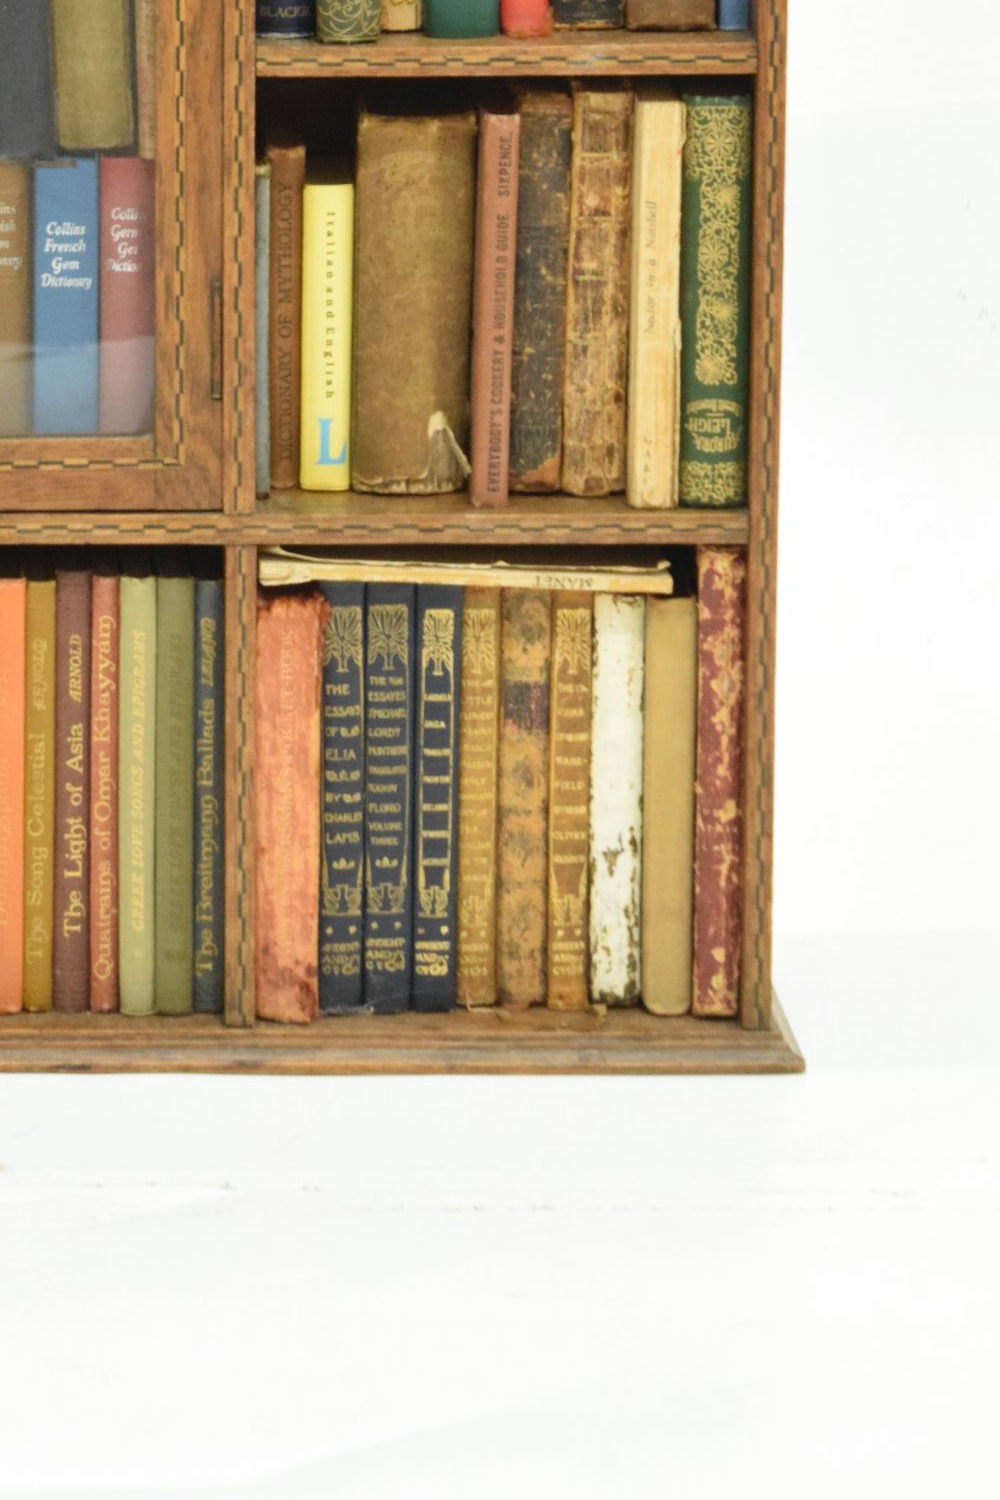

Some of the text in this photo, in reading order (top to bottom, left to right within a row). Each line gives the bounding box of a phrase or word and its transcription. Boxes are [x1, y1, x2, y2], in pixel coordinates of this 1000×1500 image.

[44, 239, 87, 253] French
[46, 221, 86, 236] Collins
[277, 181, 293, 304] MYTHOLOGY
[40, 273, 93, 290] Dictionary
[51, 257, 80, 273] Gem
[323, 211, 336, 399] Italian and English
[493, 256, 510, 329] HOUSEHOLD
[279, 315, 292, 339] OF
[490, 349, 506, 404] COOKERY
[487, 409, 503, 492] EVERYBODY'S
[688, 418, 731, 435] LEIGH
[534, 575, 594, 589] MANET
[325, 705, 361, 718] ESSAYS
[326, 684, 350, 695] THE
[197, 698, 215, 787] Ballads
[325, 749, 357, 761] ELIA
[27, 733, 46, 837] Celestial
[63, 634, 87, 938] The Light of Asia ARNOLD
[94, 751, 115, 821] Omar
[131, 630, 147, 932] GREEK LOVE SONGS AND EPIGRAMS
[94, 827, 112, 850] of
[325, 832, 360, 844] LAMB
[27, 846, 48, 906] Song
[26, 916, 49, 964] The
[93, 860, 116, 980] Quatrains
[195, 928, 218, 977] The
